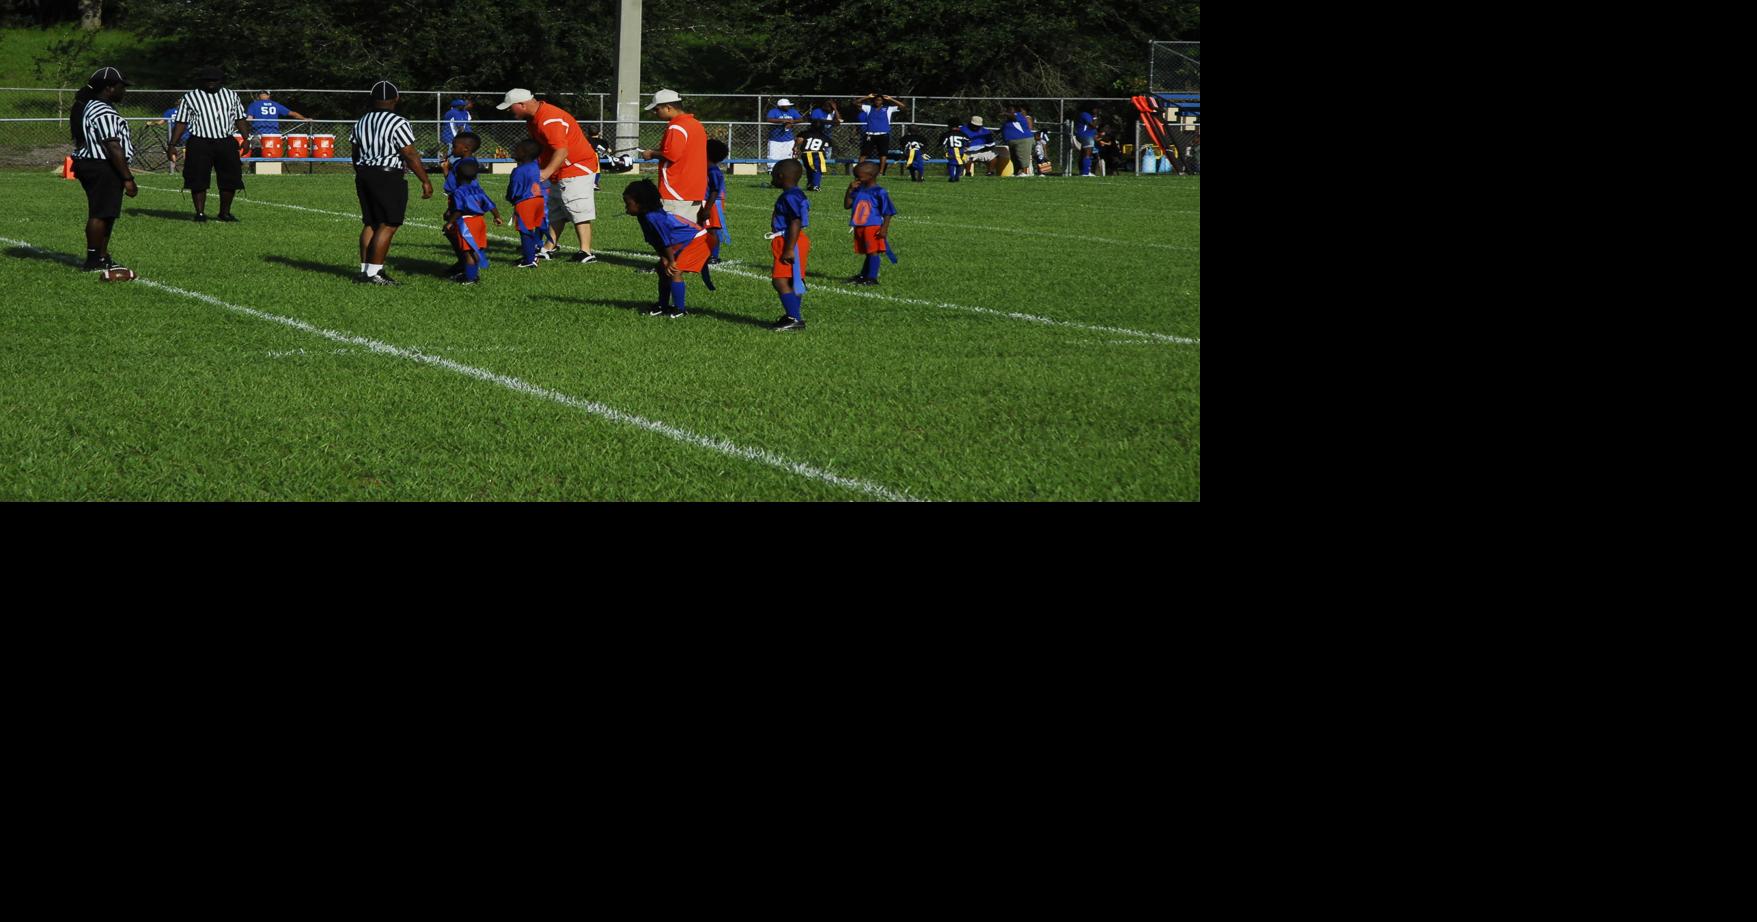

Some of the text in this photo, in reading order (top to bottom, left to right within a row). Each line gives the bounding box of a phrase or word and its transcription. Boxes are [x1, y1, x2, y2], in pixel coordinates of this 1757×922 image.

[261, 106, 277, 115] 50
[804, 137, 823, 151] 18
[949, 135, 963, 148] 15
